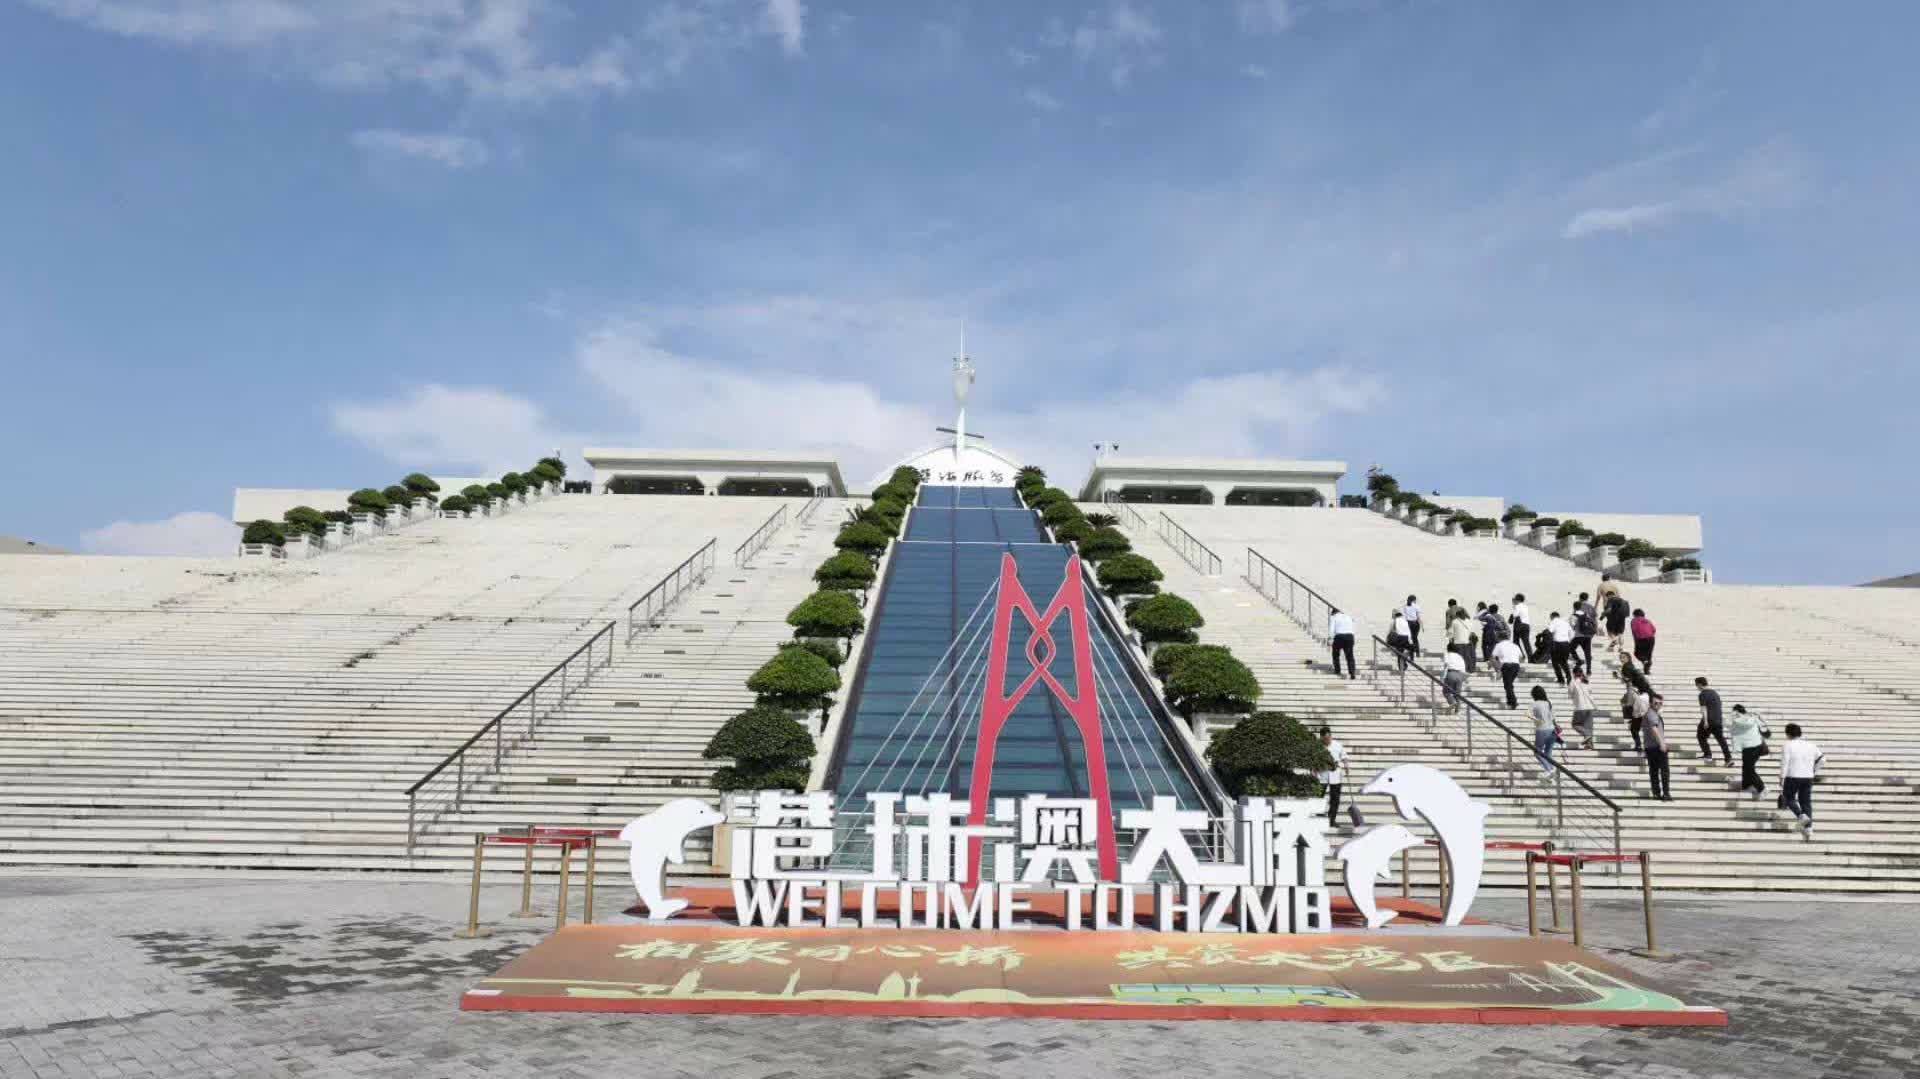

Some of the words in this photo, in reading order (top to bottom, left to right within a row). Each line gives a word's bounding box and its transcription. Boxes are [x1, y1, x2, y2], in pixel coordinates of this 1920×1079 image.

[726, 789, 1330, 886] 港珠澳大桥
[732, 879, 1034, 930] WELCOME
[1052, 881, 1134, 931] TO
[1156, 883, 1331, 933] HZMB
